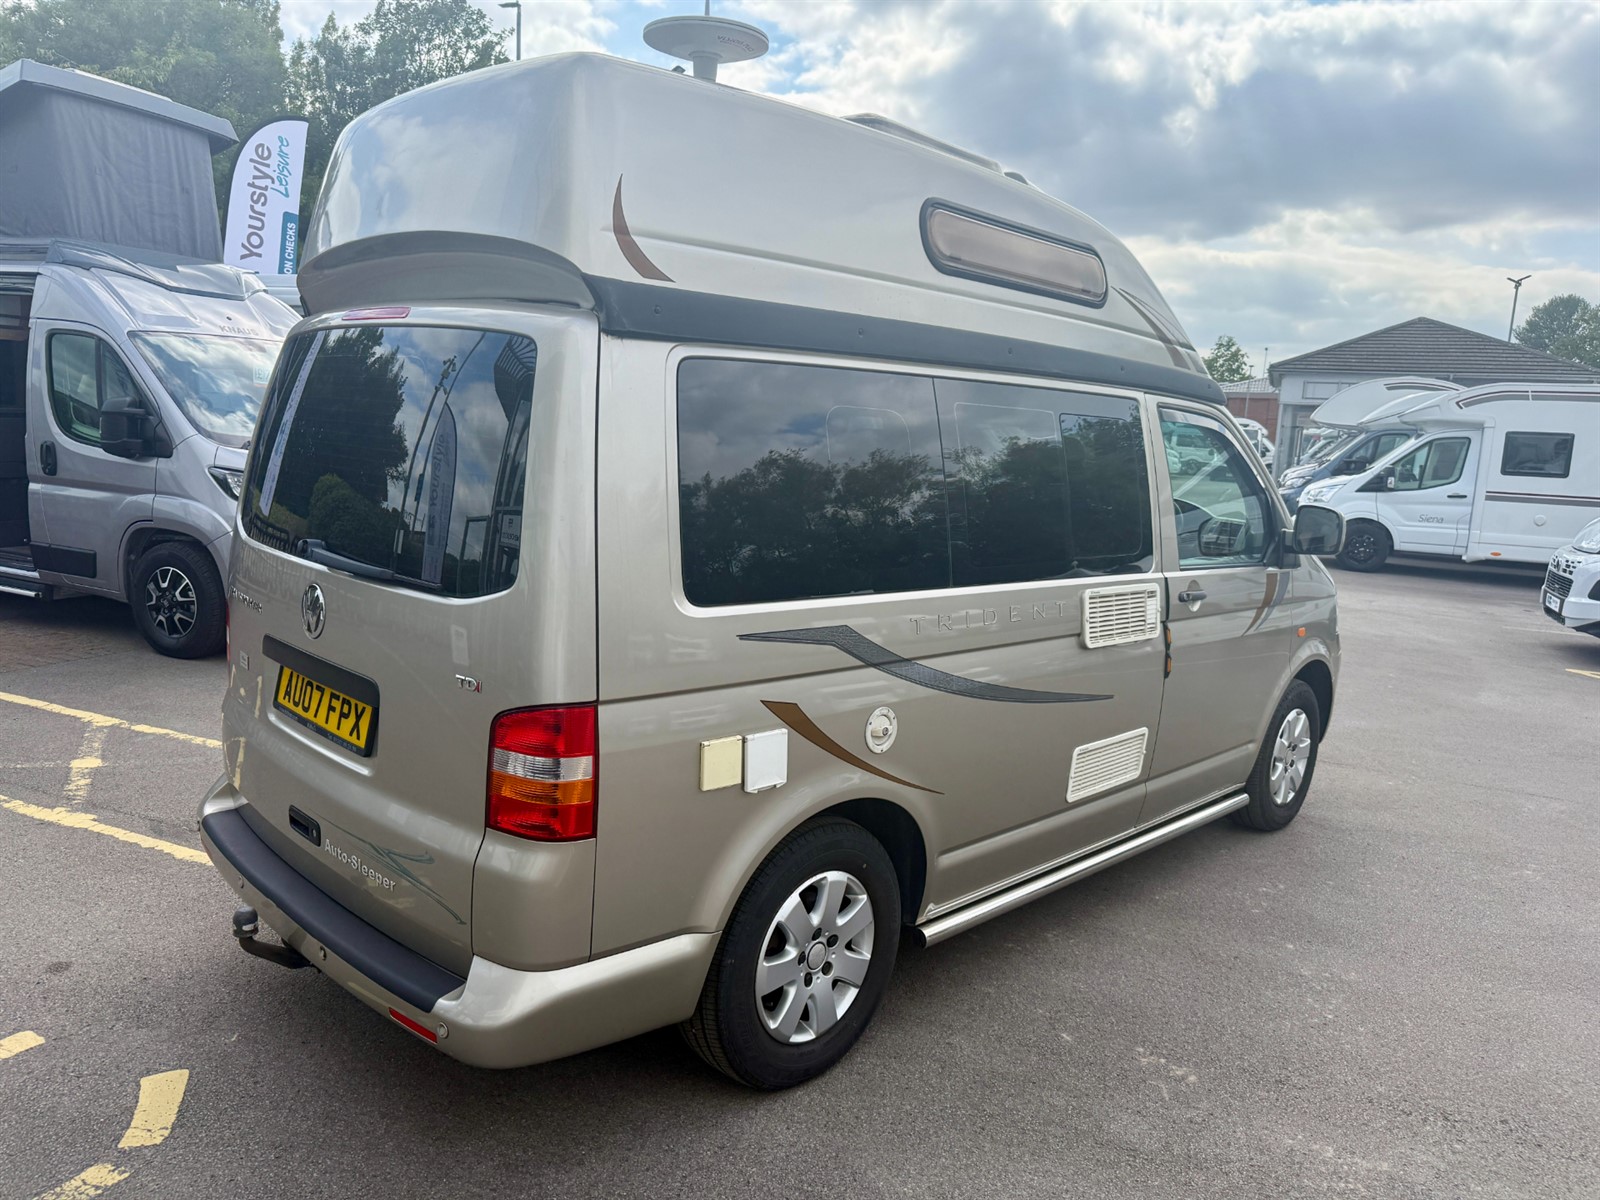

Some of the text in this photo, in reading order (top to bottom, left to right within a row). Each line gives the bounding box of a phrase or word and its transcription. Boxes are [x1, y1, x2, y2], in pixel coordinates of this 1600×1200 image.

[270, 135, 292, 198] Leisure
[240, 142, 275, 260] Yourstyle
[285, 222, 296, 259] CHECKS
[219, 325, 259, 336] KNAUS
[1418, 514, 1444, 524] Siena
[909, 600, 1067, 636] TRIDENT
[455, 674, 482, 693] TDI
[283, 670, 367, 741] AU07 FPX
[324, 838, 396, 892] Auto-Sleeper
